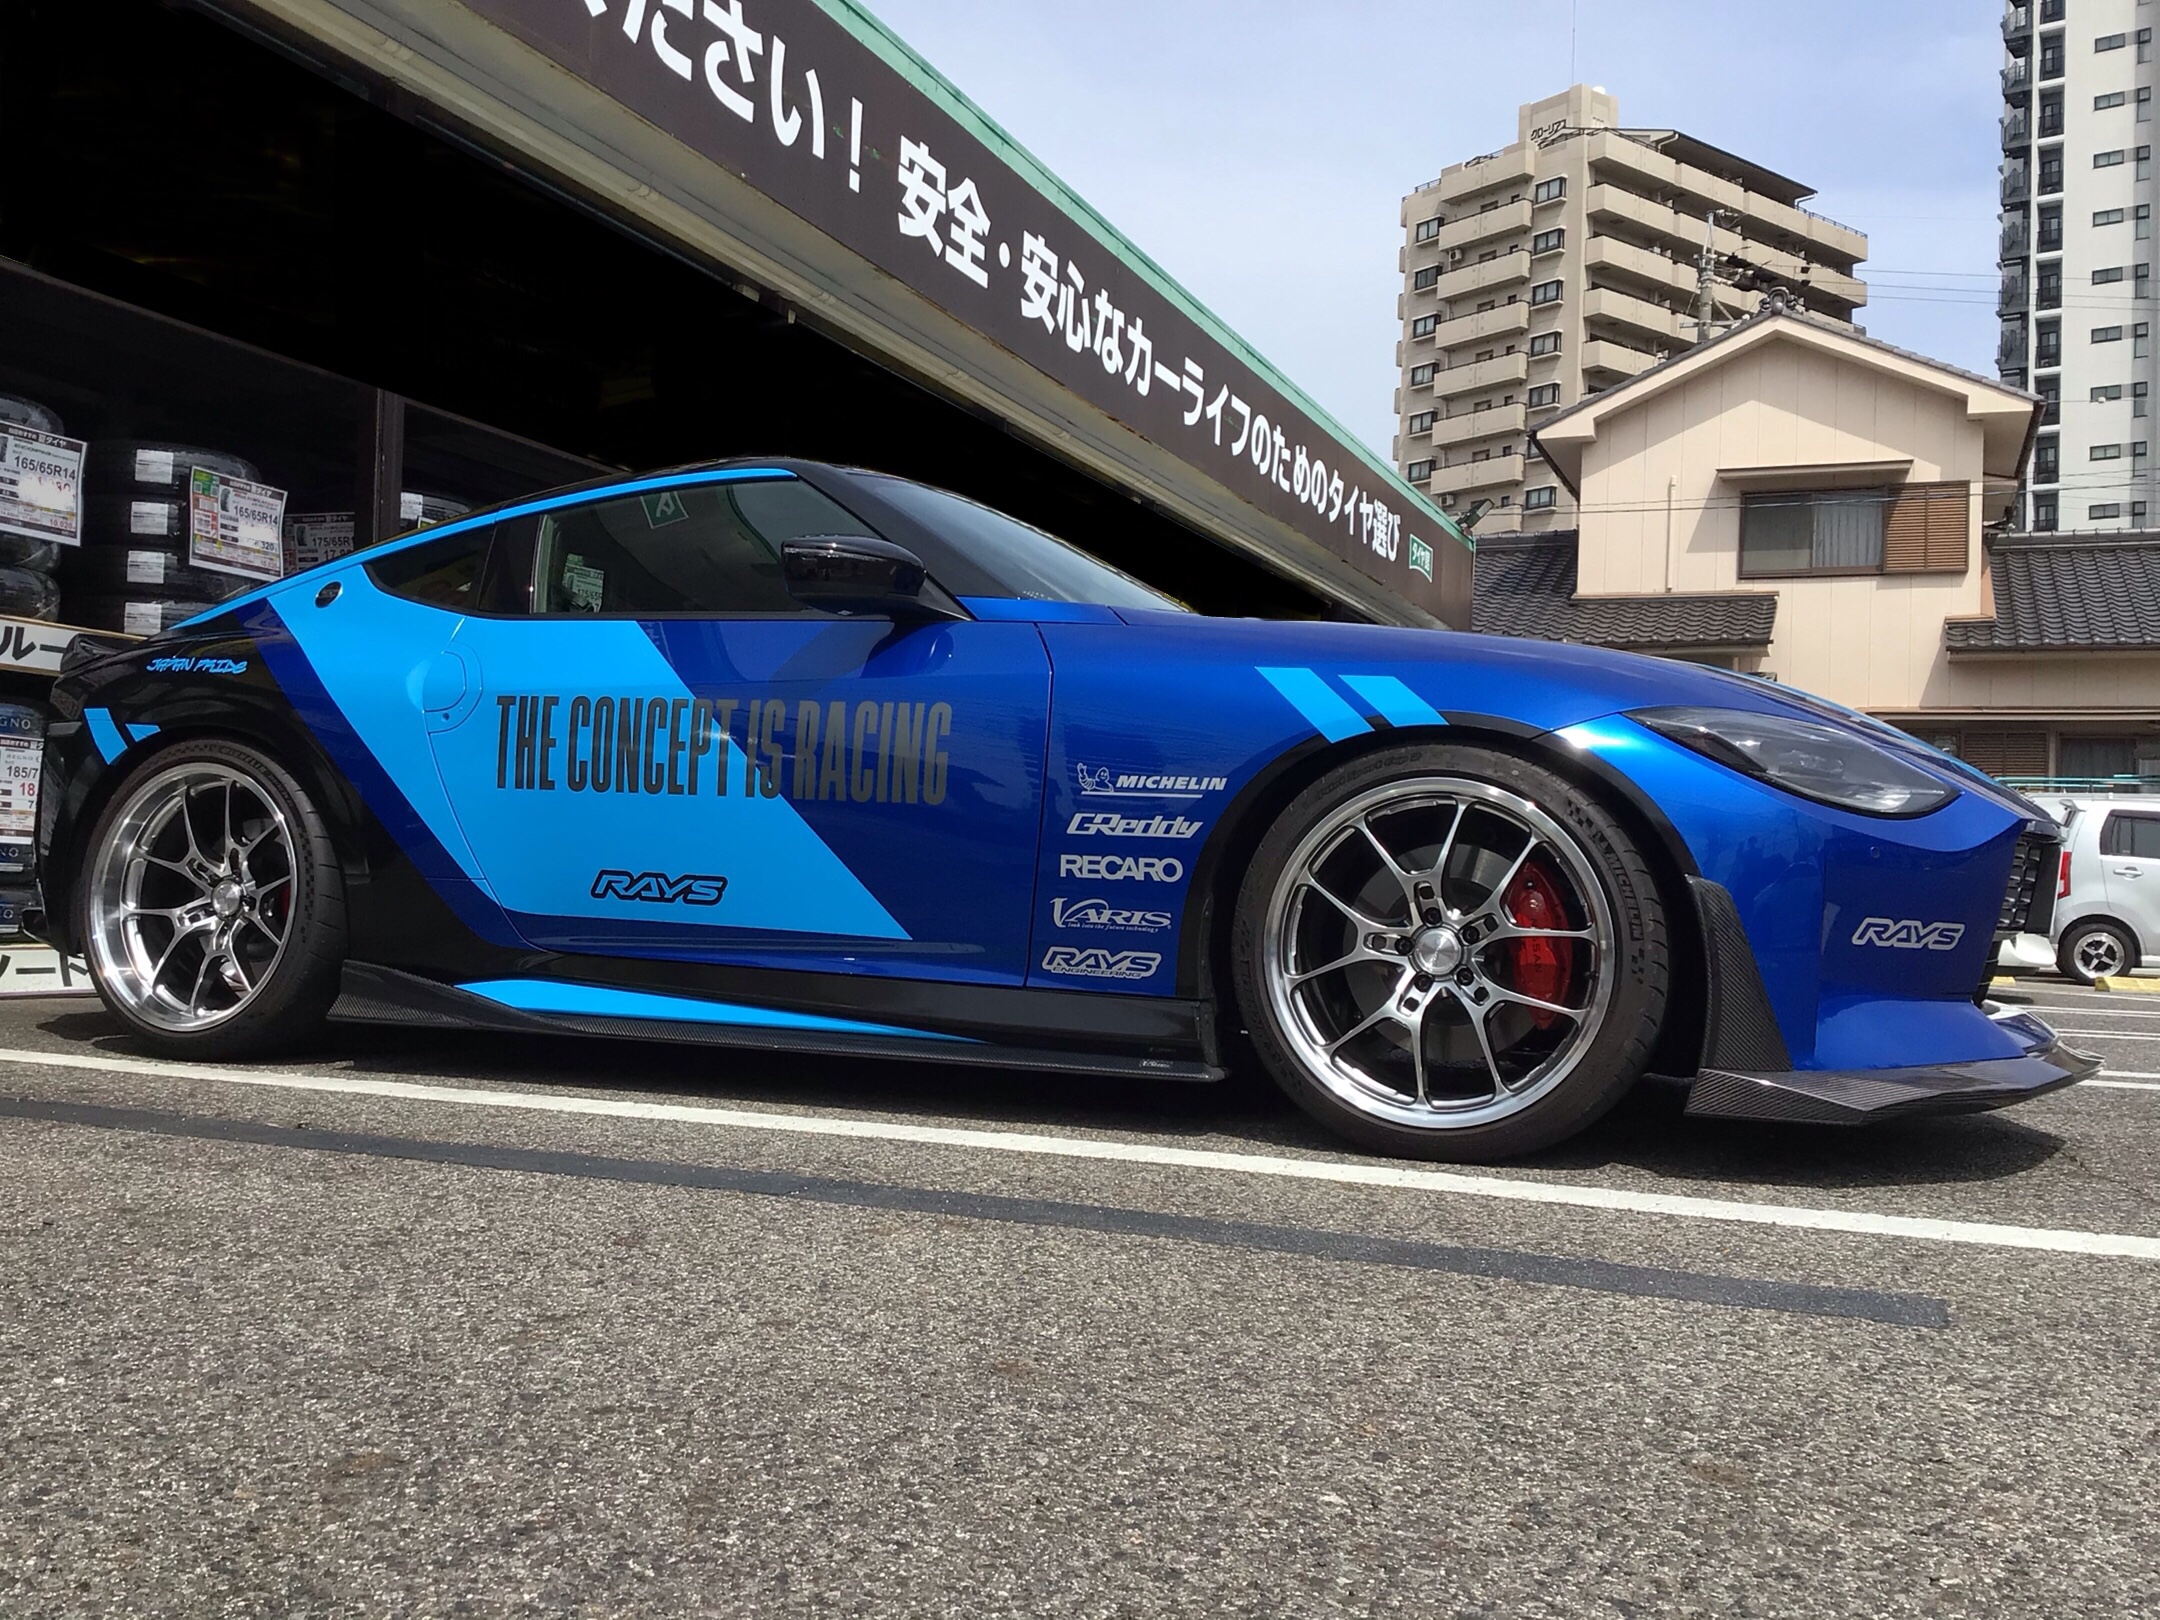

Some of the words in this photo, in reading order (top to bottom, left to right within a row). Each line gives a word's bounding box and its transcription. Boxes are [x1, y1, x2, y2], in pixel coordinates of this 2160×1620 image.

[14, 455, 76, 481] 165/65R14
[234, 505, 278, 525] 165/65R14
[146, 657, 195, 672] JAPAN
[497, 695, 559, 791] THE
[567, 695, 741, 797] CONCEPT
[745, 699, 786, 799] IS
[793, 700, 953, 806] RACING
[7, 765, 39, 779] 185/7
[1116, 775, 1228, 791] MICHELIN
[20, 782, 36, 797] 18
[1066, 812, 1204, 839] GReddy
[1060, 854, 1184, 883] RECARO
[591, 868, 729, 907] RAYS
[1852, 917, 1965, 951] RAYS
[1044, 948, 1159, 973] RAYS
[1052, 966, 1142, 978] ENGINEERING
